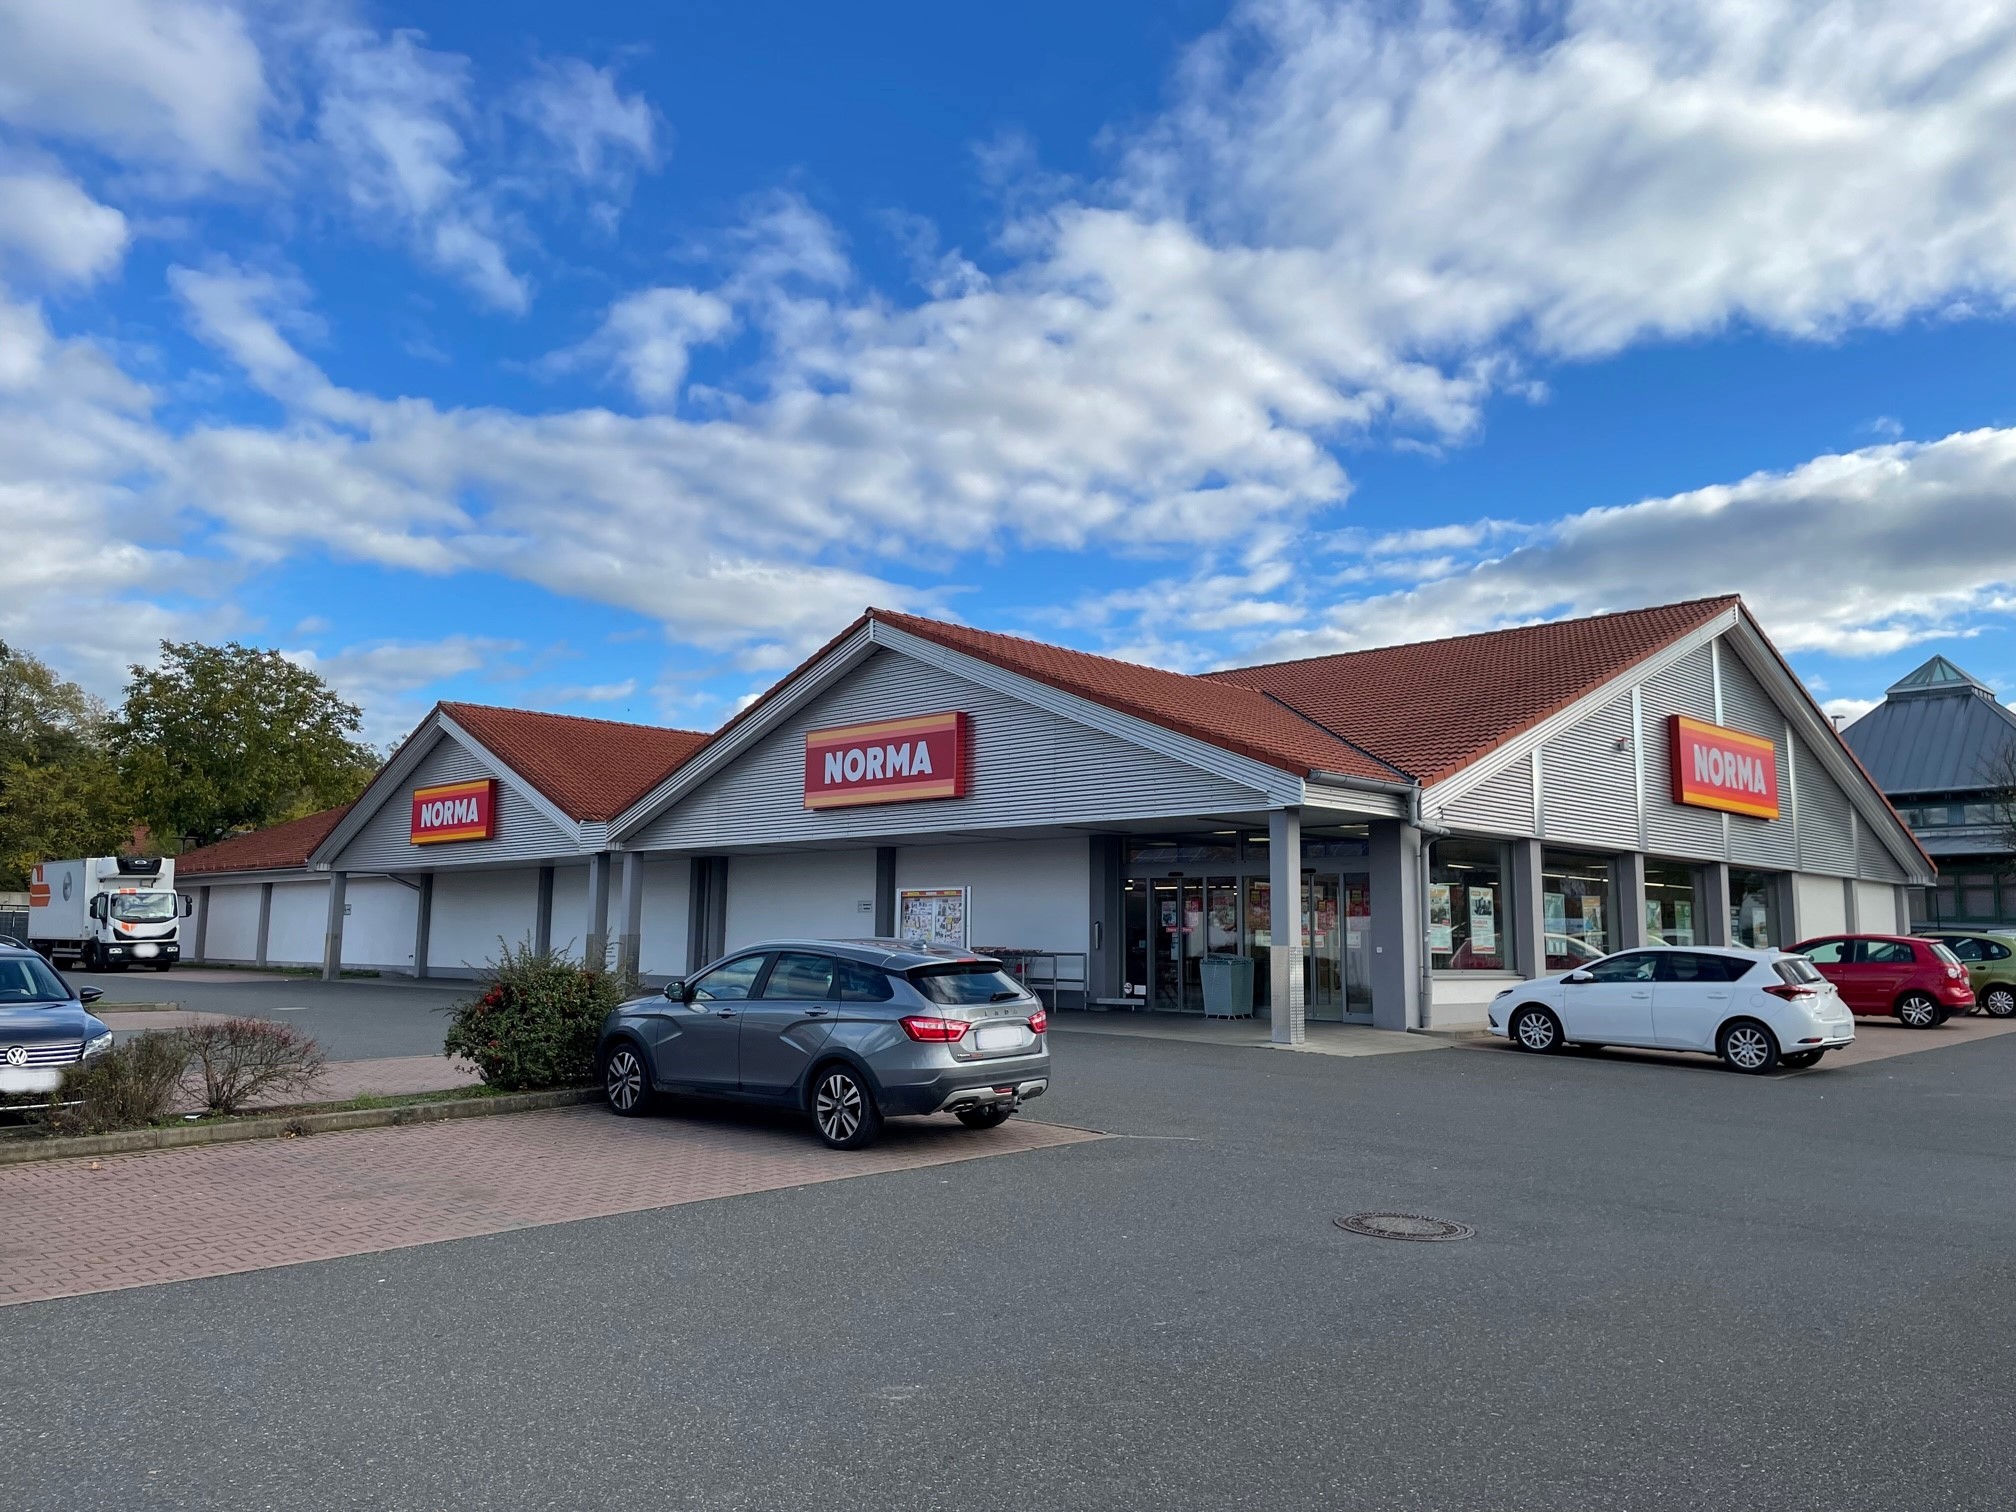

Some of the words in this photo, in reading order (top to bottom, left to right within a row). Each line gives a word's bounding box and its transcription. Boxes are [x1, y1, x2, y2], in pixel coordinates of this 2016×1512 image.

[824, 740, 933, 785] NORMA
[1693, 743, 1767, 796] NORMA
[420, 797, 479, 828] NORMA
